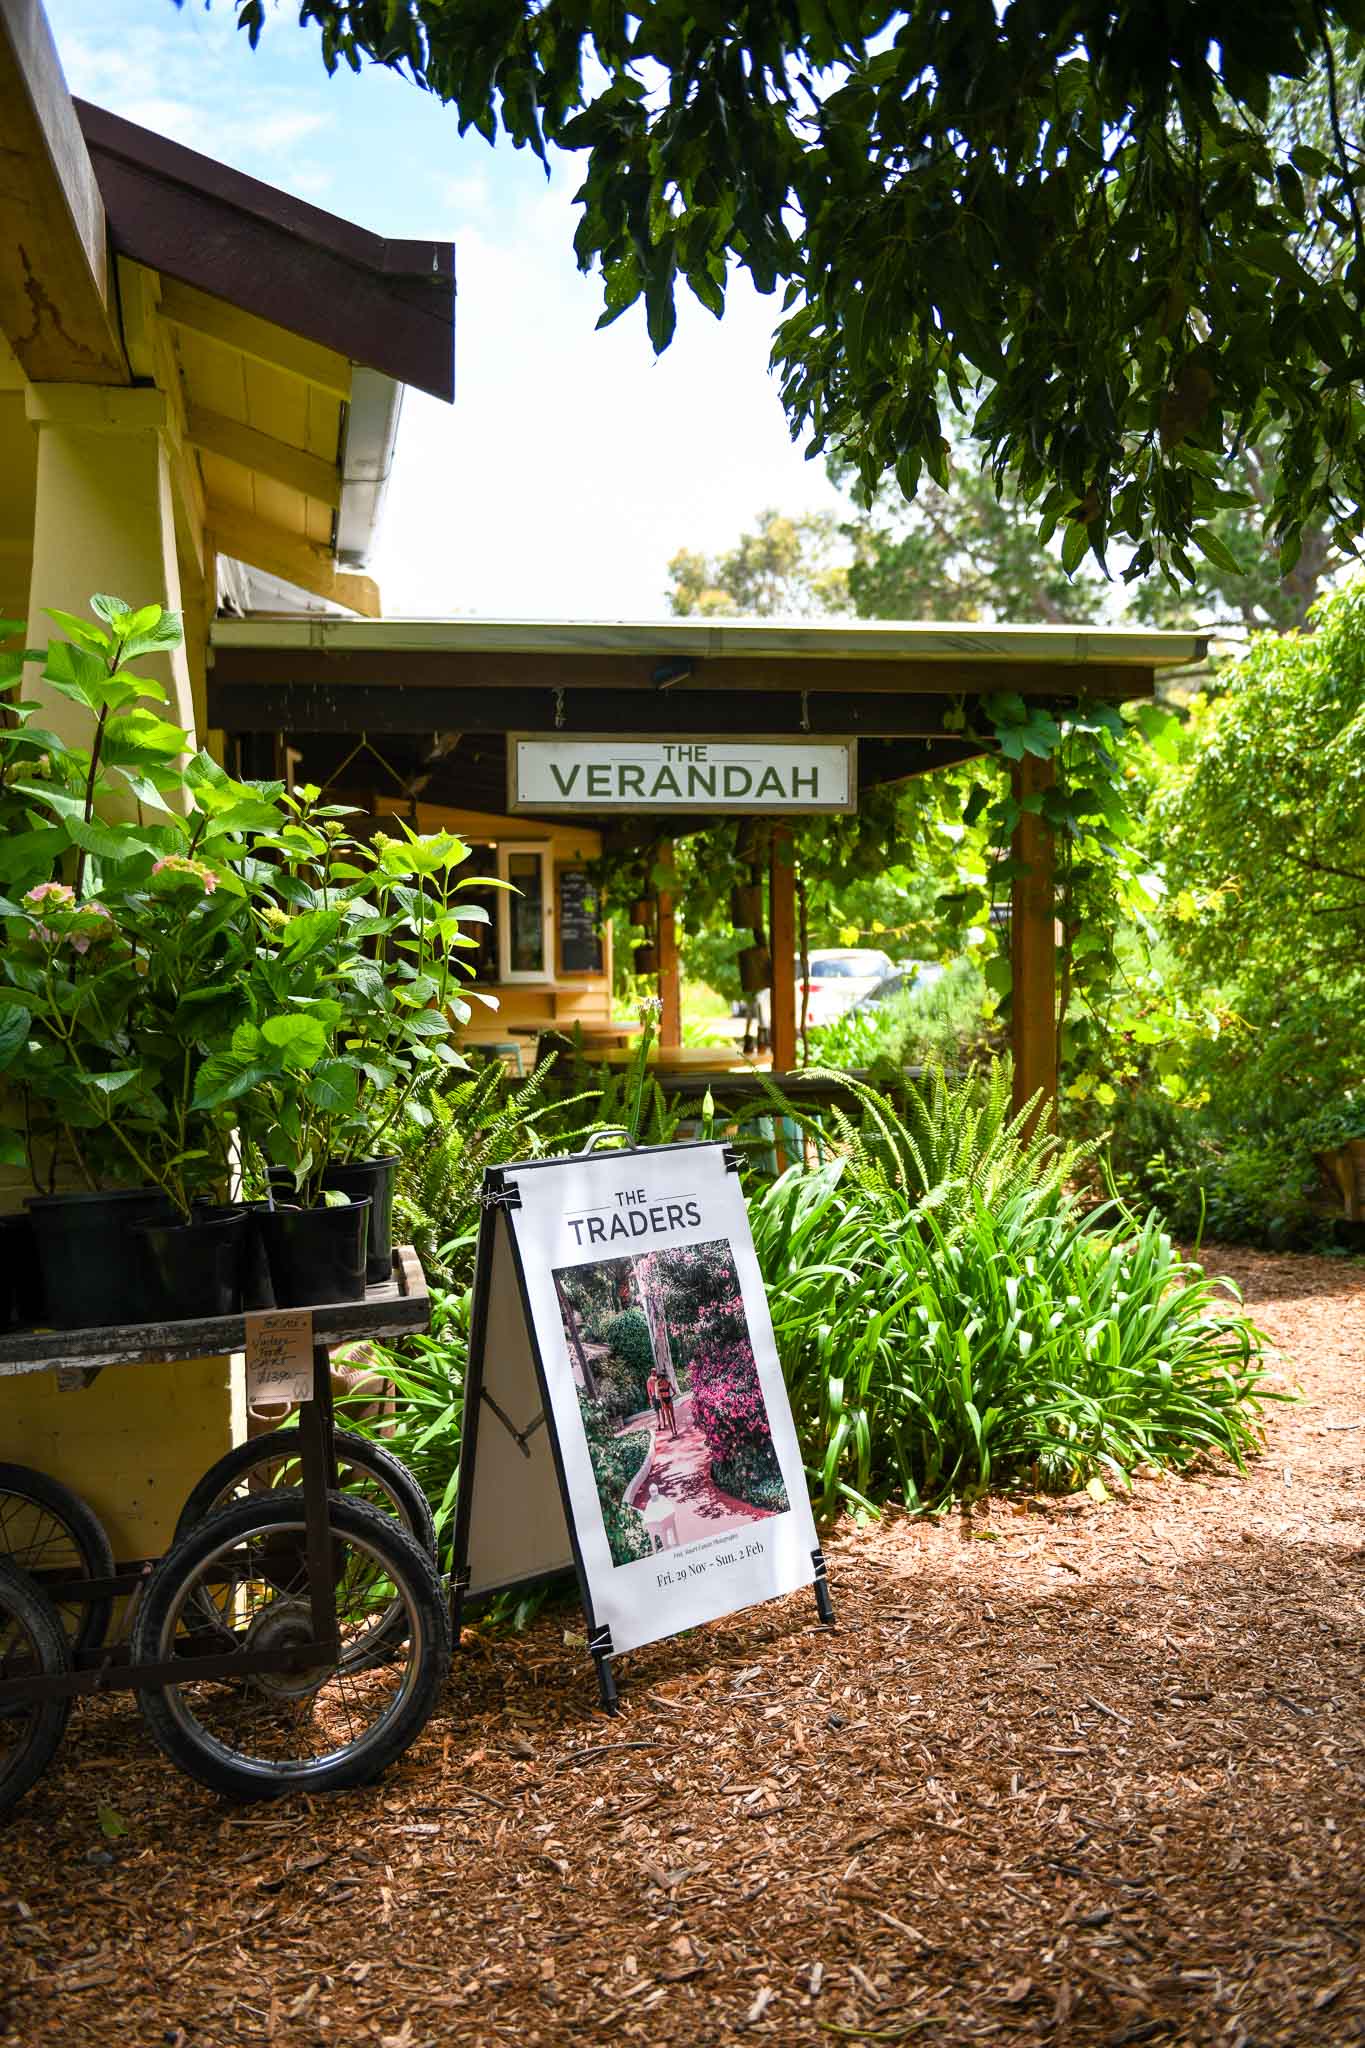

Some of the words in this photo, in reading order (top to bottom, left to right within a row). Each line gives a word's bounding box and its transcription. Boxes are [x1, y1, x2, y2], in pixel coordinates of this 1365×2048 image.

[663, 745, 708, 762] THE
[549, 764, 819, 799] VERANDAH
[615, 1189, 647, 1207] THE
[568, 1202, 701, 1246] TRADERS
[657, 1572, 674, 1587] Fri.
[676, 1569, 687, 1581] 29
[688, 1562, 706, 1577] Nov
[715, 1553, 737, 1567] Sun.
[739, 1550, 745, 1560] 2
[746, 1540, 764, 1557] Feb
